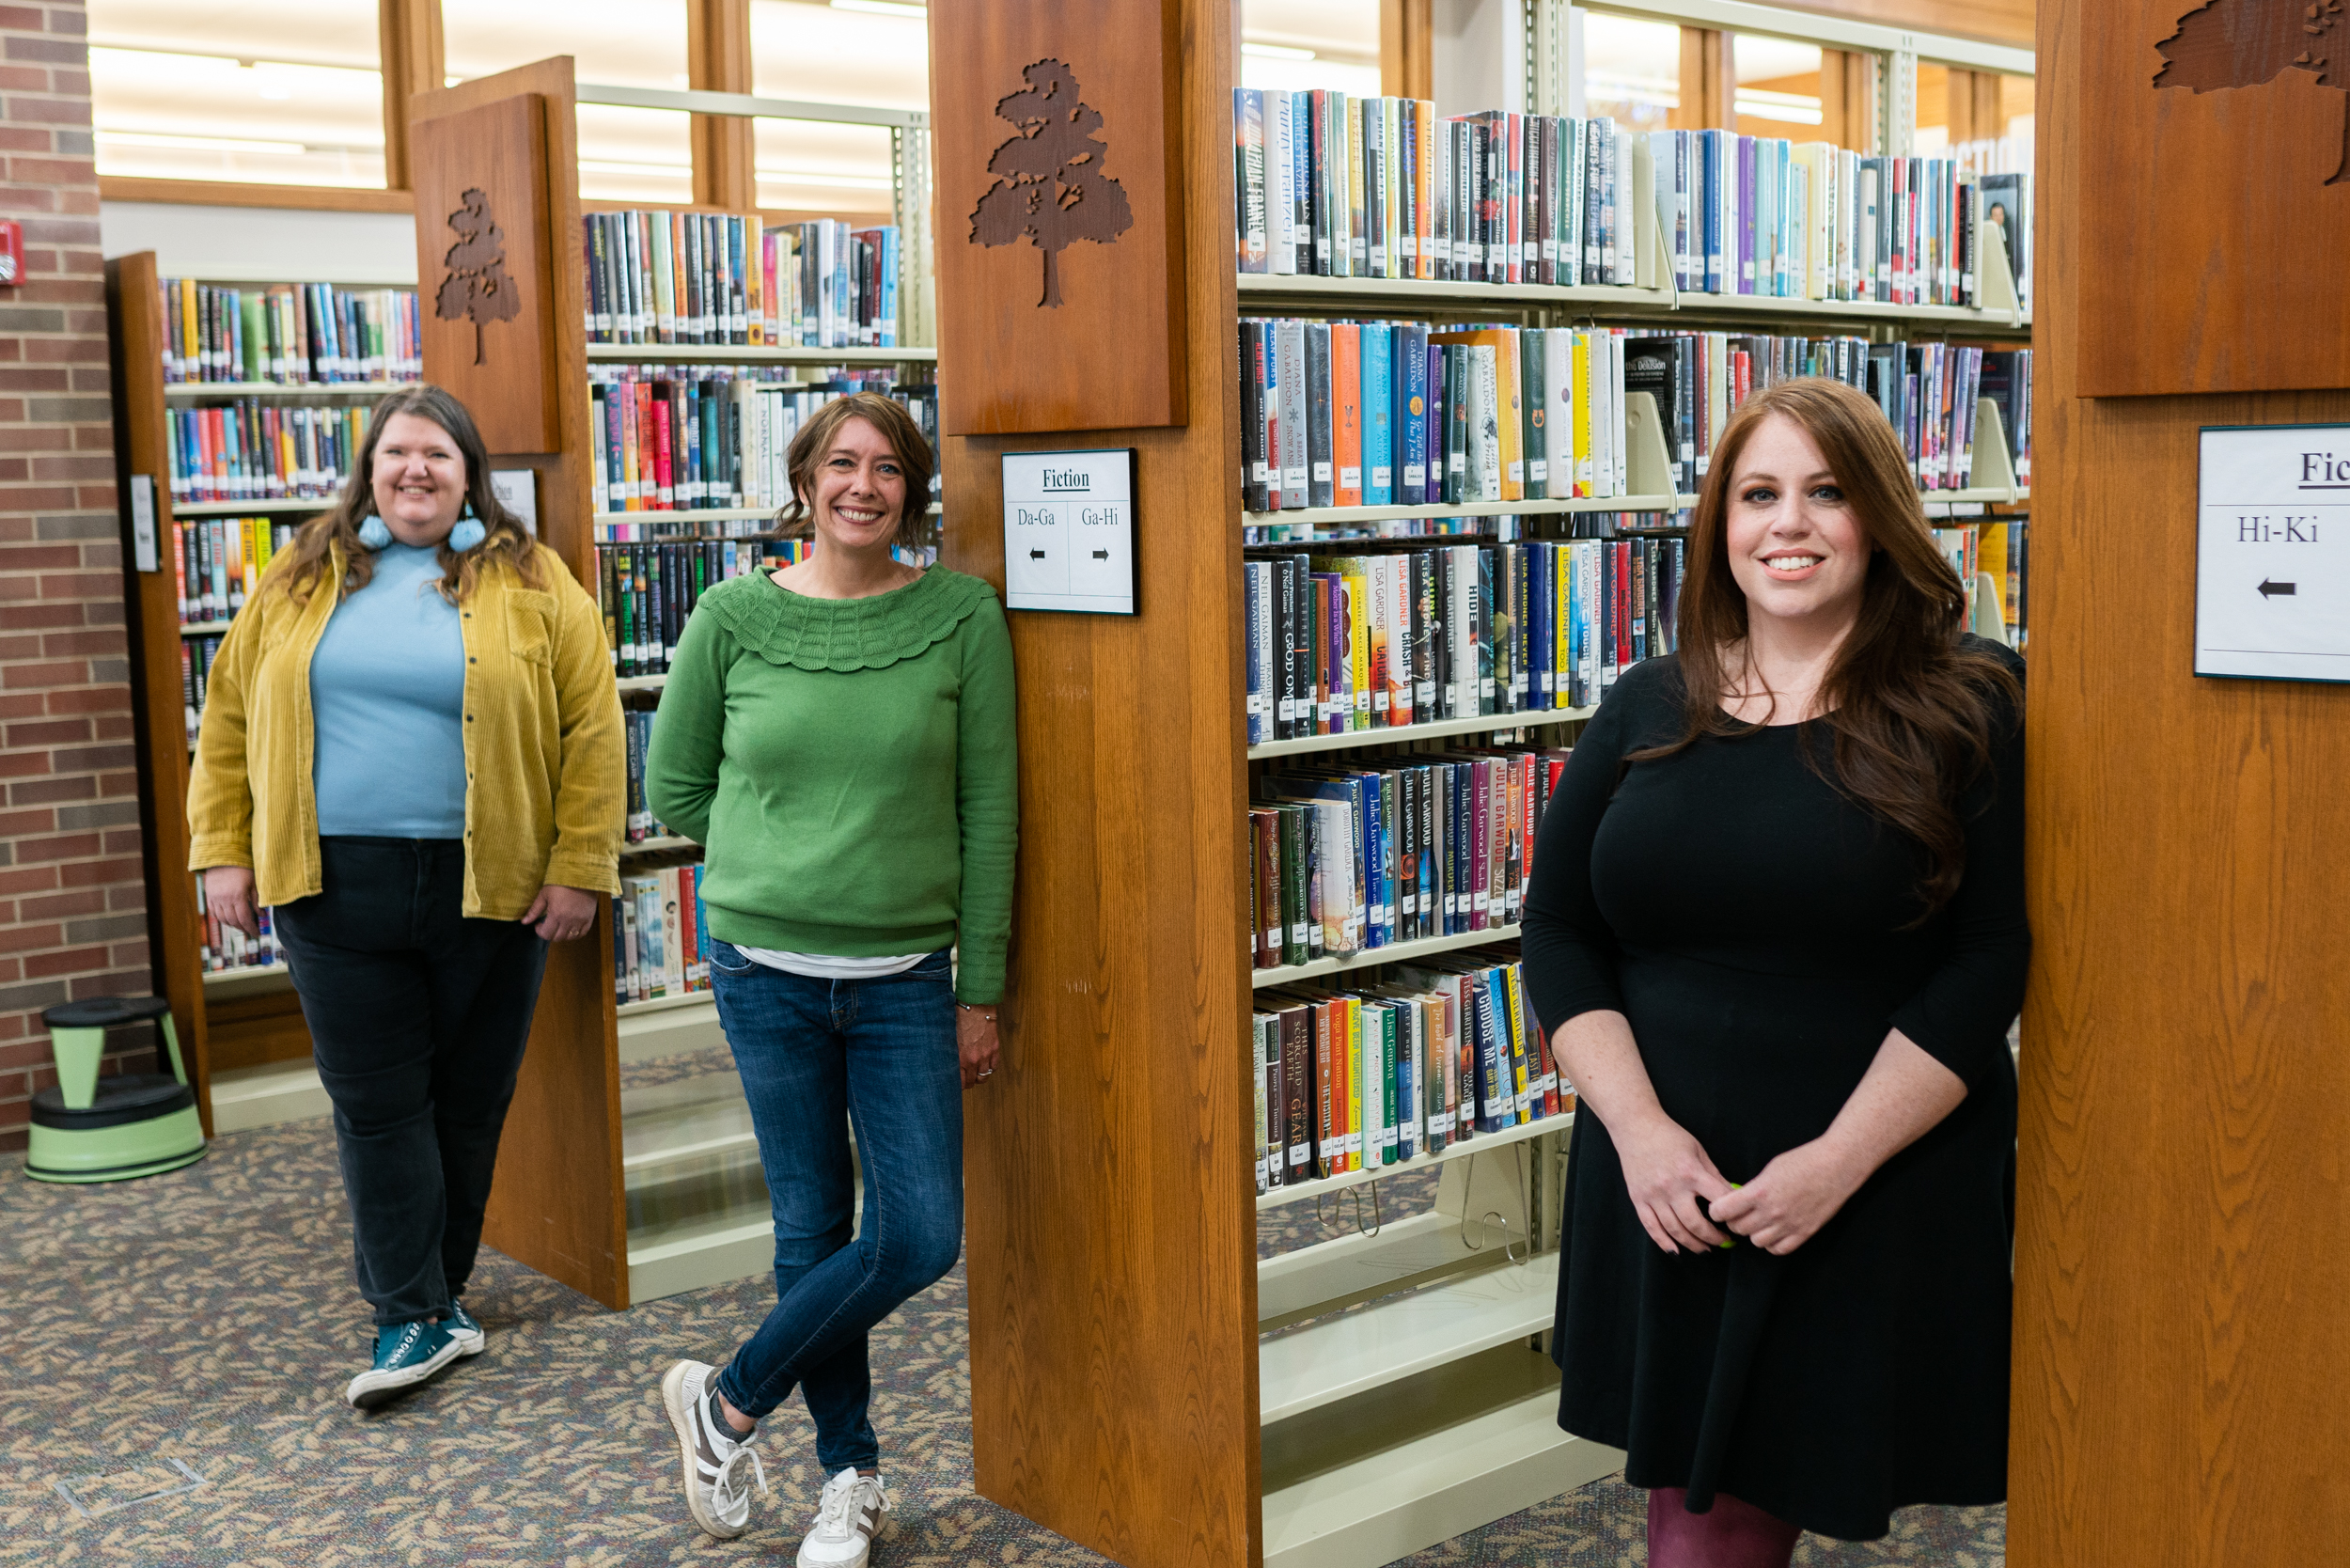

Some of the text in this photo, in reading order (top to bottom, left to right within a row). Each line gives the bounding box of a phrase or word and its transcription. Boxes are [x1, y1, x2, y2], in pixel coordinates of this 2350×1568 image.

[1277, 99, 1292, 155] Purity
[1352, 105, 1360, 163] FRAZIER
[1474, 154, 1482, 174] STAR
[1589, 123, 1600, 189] HEAVEN'S FURY
[1474, 176, 1482, 201] RISING
[1255, 342, 1264, 384] ALAN FURST
[1283, 345, 1293, 406] GABALDON
[1293, 359, 1302, 396] DIANA
[1409, 339, 1418, 393] GABALDON
[1417, 351, 1425, 383] DIANA
[1481, 354, 1493, 416] GABALDON
[1489, 368, 1497, 402] DIANA
[760, 409, 769, 461] NORMAL
[1285, 426, 1294, 448] SNOW
[1042, 468, 1089, 488] Fiction
[2298, 451, 2350, 482] Fic
[1018, 508, 1055, 526] Da-Ga
[1082, 507, 1119, 526] Ga-Hi
[2235, 514, 2319, 543] Hi-Ki
[1581, 549, 1590, 567] LISA
[1250, 569, 1260, 649] NEIL GAIMAN
[1261, 574, 1270, 651] NEIL GAIMAN
[1332, 585, 1340, 611] Mother
[1375, 567, 1386, 631] LISA GARDNER
[1398, 560, 1408, 627] LISA GARDNER
[1447, 565, 1456, 653] LISA GARDNER
[1468, 586, 1479, 621] HIDE
[1609, 549, 1618, 636] LISA GARDNER
[1636, 577, 1645, 618] GARDNER
[1333, 624, 1341, 646] Witch
[1421, 590, 1431, 643] GARDNER
[1284, 632, 1295, 671] GOOD
[1376, 645, 1387, 681] CATCH
[1402, 632, 1412, 666] CRASH
[1582, 624, 1590, 659] TOUCH
[1509, 766, 1517, 787] JULIE
[1527, 763, 1535, 836] JULIE GARWOOD
[1353, 807, 1361, 849] GARWOOD
[1404, 776, 1415, 853] JULIE GARWOOD
[1422, 772, 1432, 845] JULIE GARWOOD
[1461, 783, 1472, 860] Julie Garwood
[1478, 781, 1489, 858] Julie Garwood
[1495, 766, 1505, 863] JULIE GARWOOD
[1370, 793, 1383, 873] Julie Garwood
[1343, 842, 1353, 872] GARLOCK
[1463, 979, 1474, 1047] TESS GERRITSEN
[1478, 995, 1497, 1067] CHOOSE ME
[1493, 973, 1508, 1046] TESS GERRITSEN
[1510, 972, 1525, 1052] TESS GERRITSEN
[1286, 1042, 1295, 1082] EARTH
[1293, 1020, 1303, 1087] SCORCHED
[1334, 1011, 1343, 1090] Yoga Pant Nation
[1352, 1004, 1361, 1099] YOU'VE BEEN VOLUNTEERED
[1386, 1013, 1396, 1079] Lisa Genova
[1403, 1039, 1412, 1084] neglected
[1501, 1058, 1512, 1077] ICE
[1527, 1051, 1539, 1073] LAST
[1323, 1084, 1331, 1097] THE
[1436, 1092, 1445, 1111] Nina
[1291, 1097, 1302, 1145] GEAR
